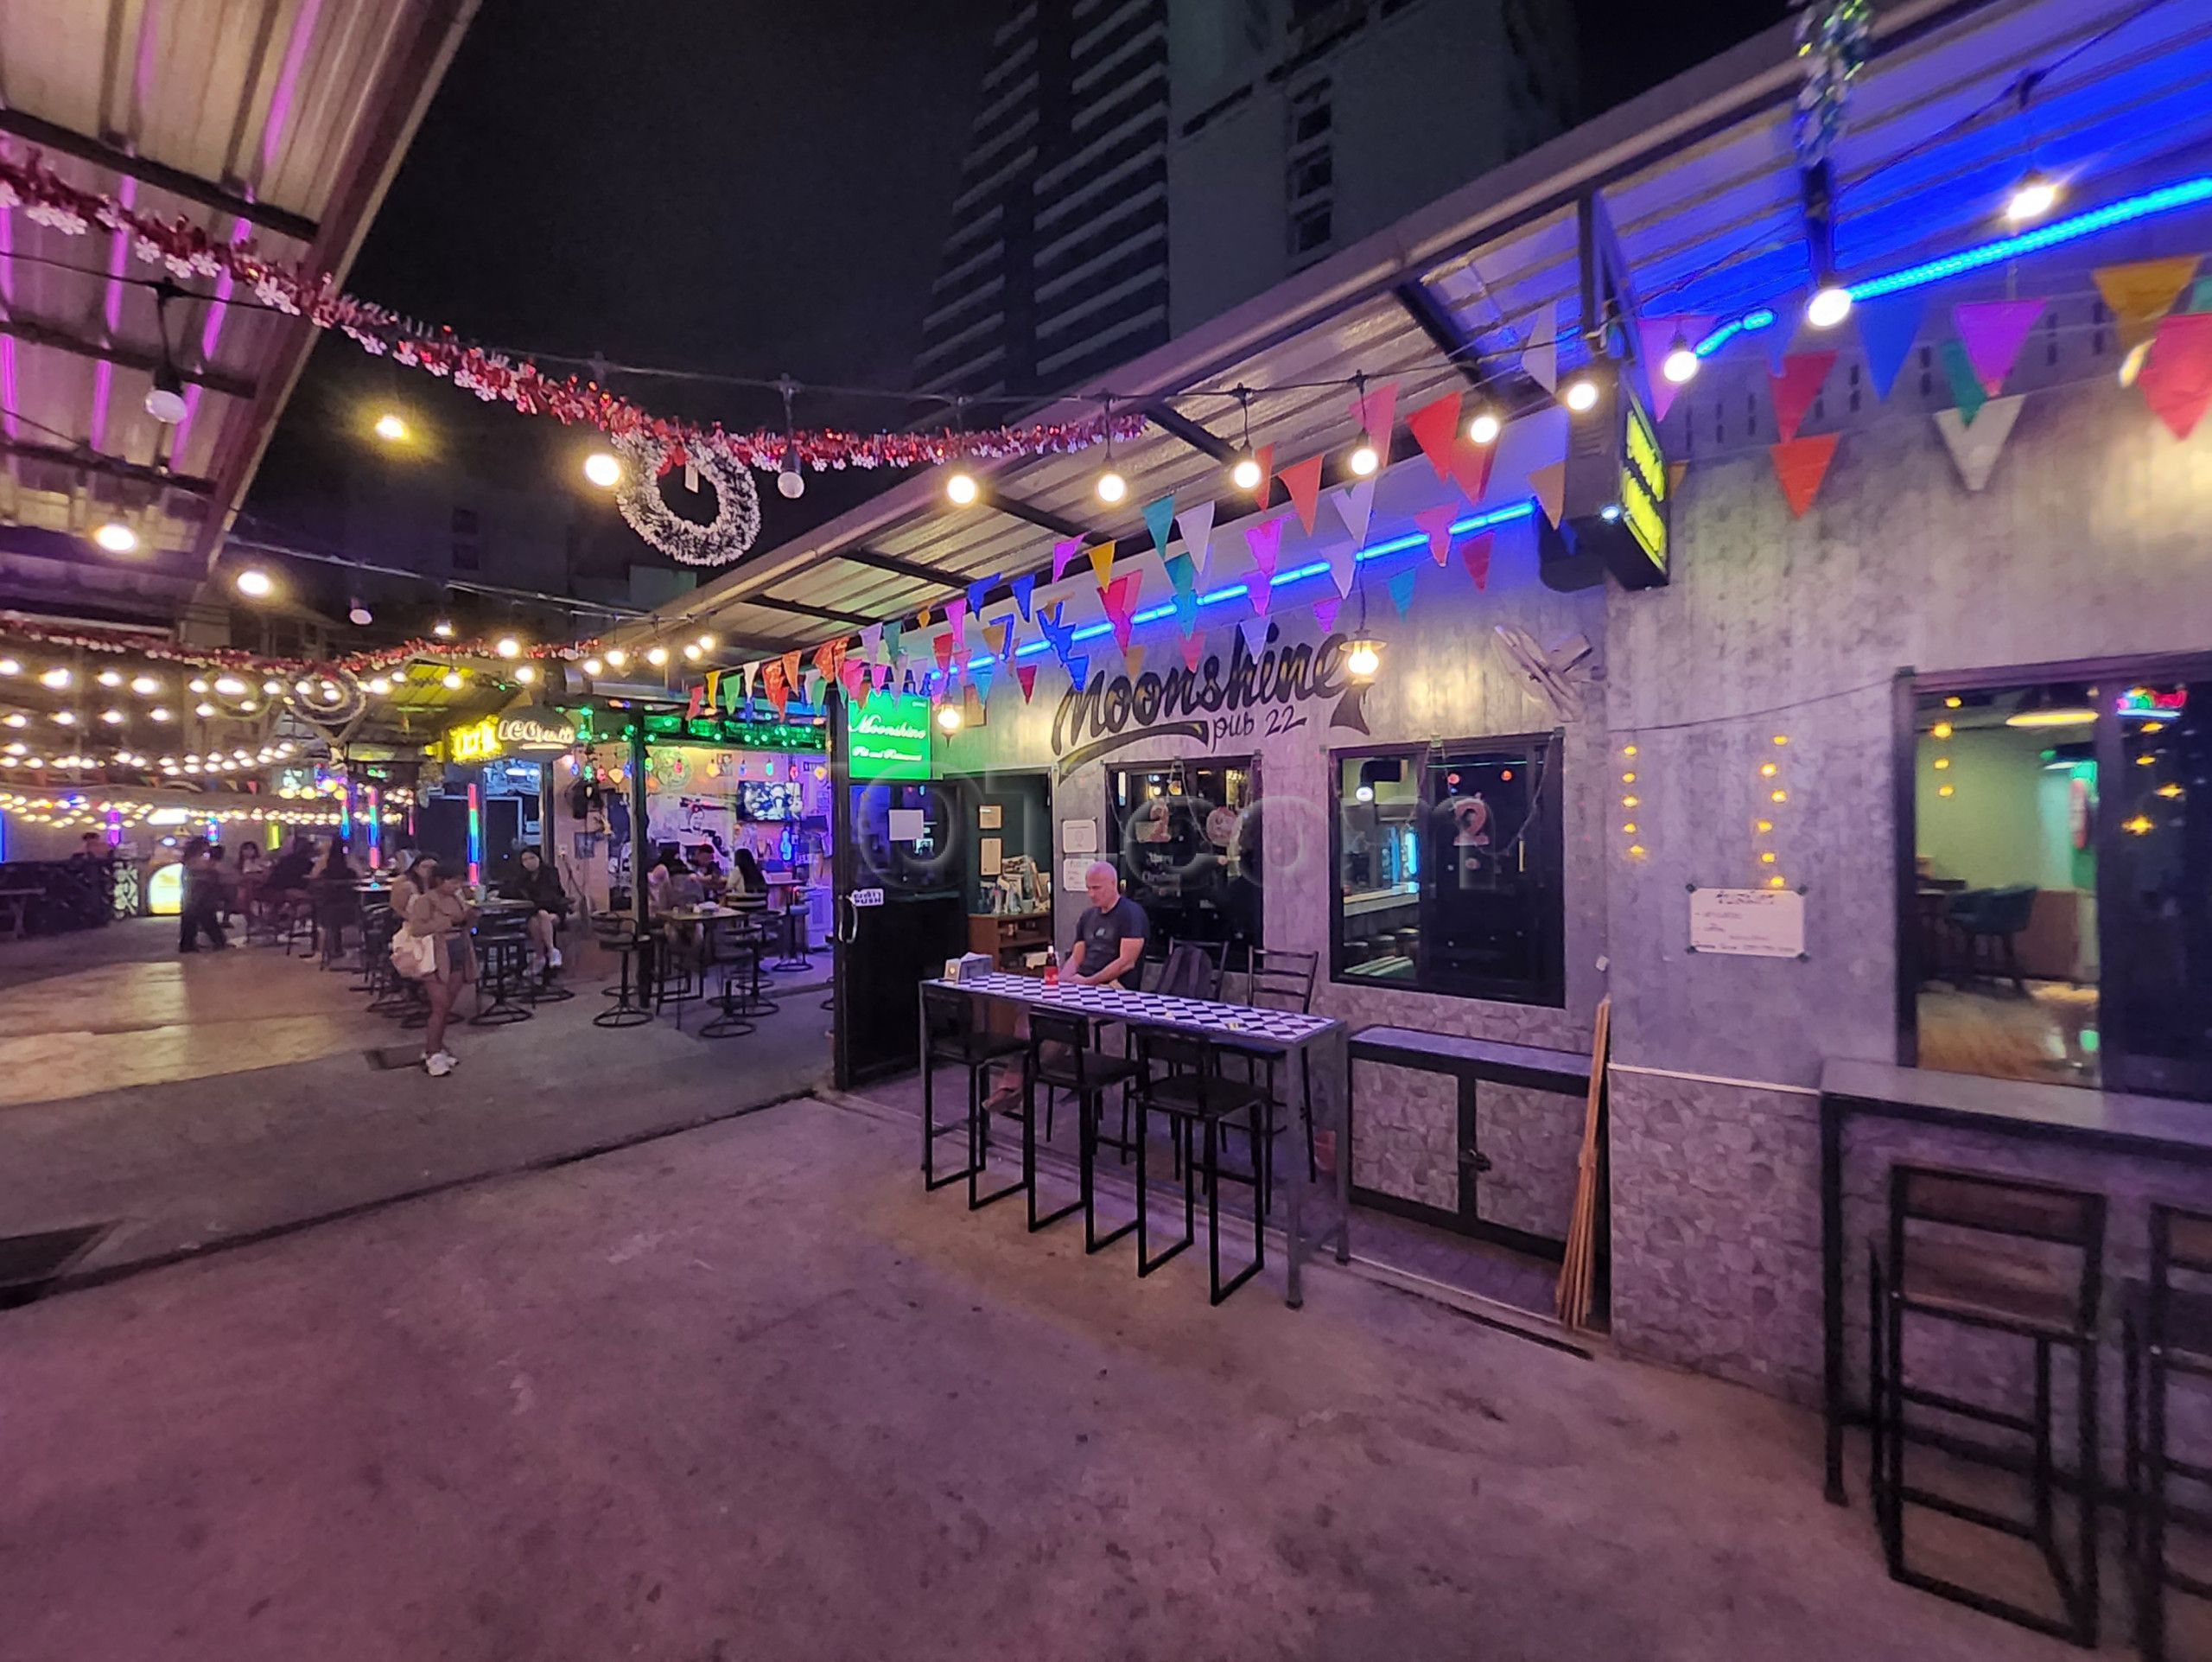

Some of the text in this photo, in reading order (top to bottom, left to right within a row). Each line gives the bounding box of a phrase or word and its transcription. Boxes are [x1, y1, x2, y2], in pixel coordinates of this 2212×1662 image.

[1052, 622, 1368, 755] Moonshine
[1211, 704, 1306, 753] pub 22
